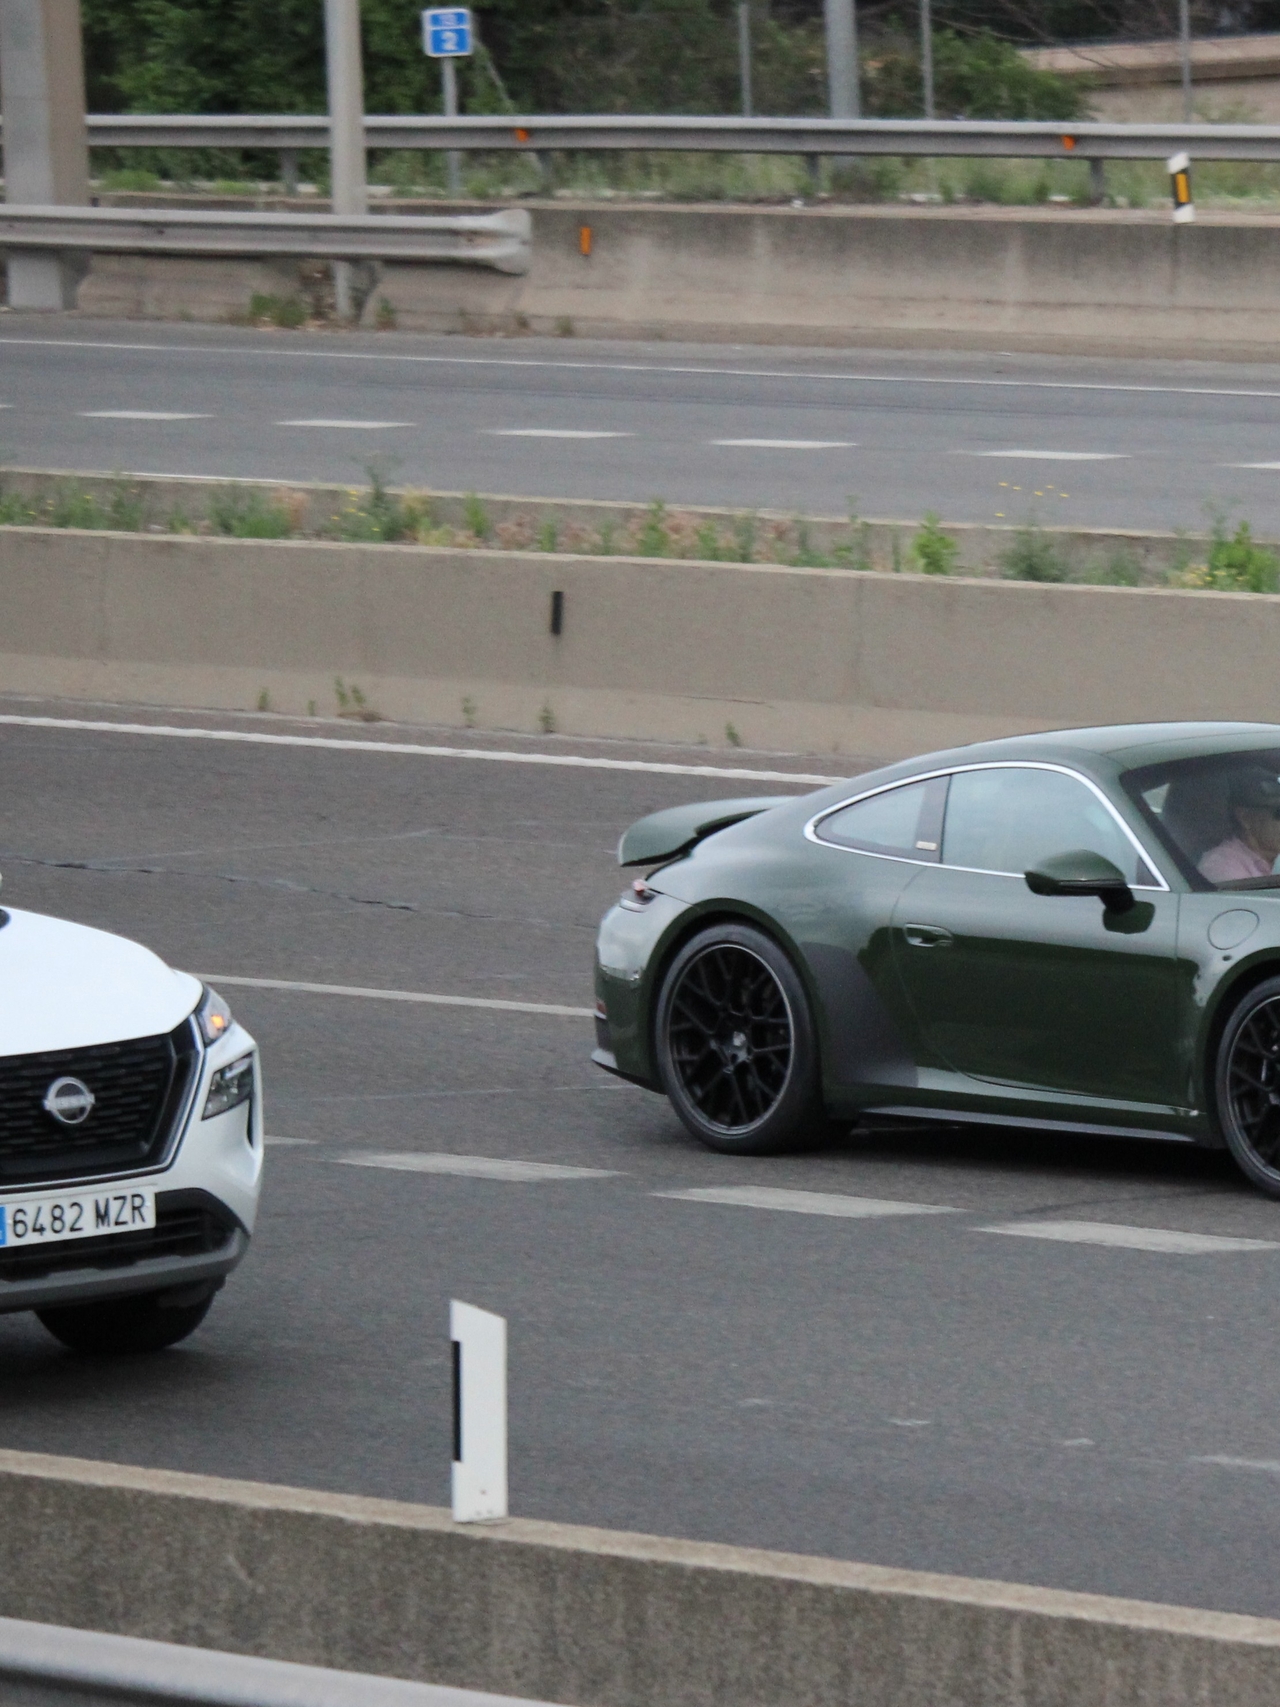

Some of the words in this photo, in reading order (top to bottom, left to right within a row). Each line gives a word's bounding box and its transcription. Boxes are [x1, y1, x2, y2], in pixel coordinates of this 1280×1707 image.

[441, 31, 458, 50] 2
[12, 1202, 84, 1238] 6482
[95, 1193, 147, 1229] MZR
